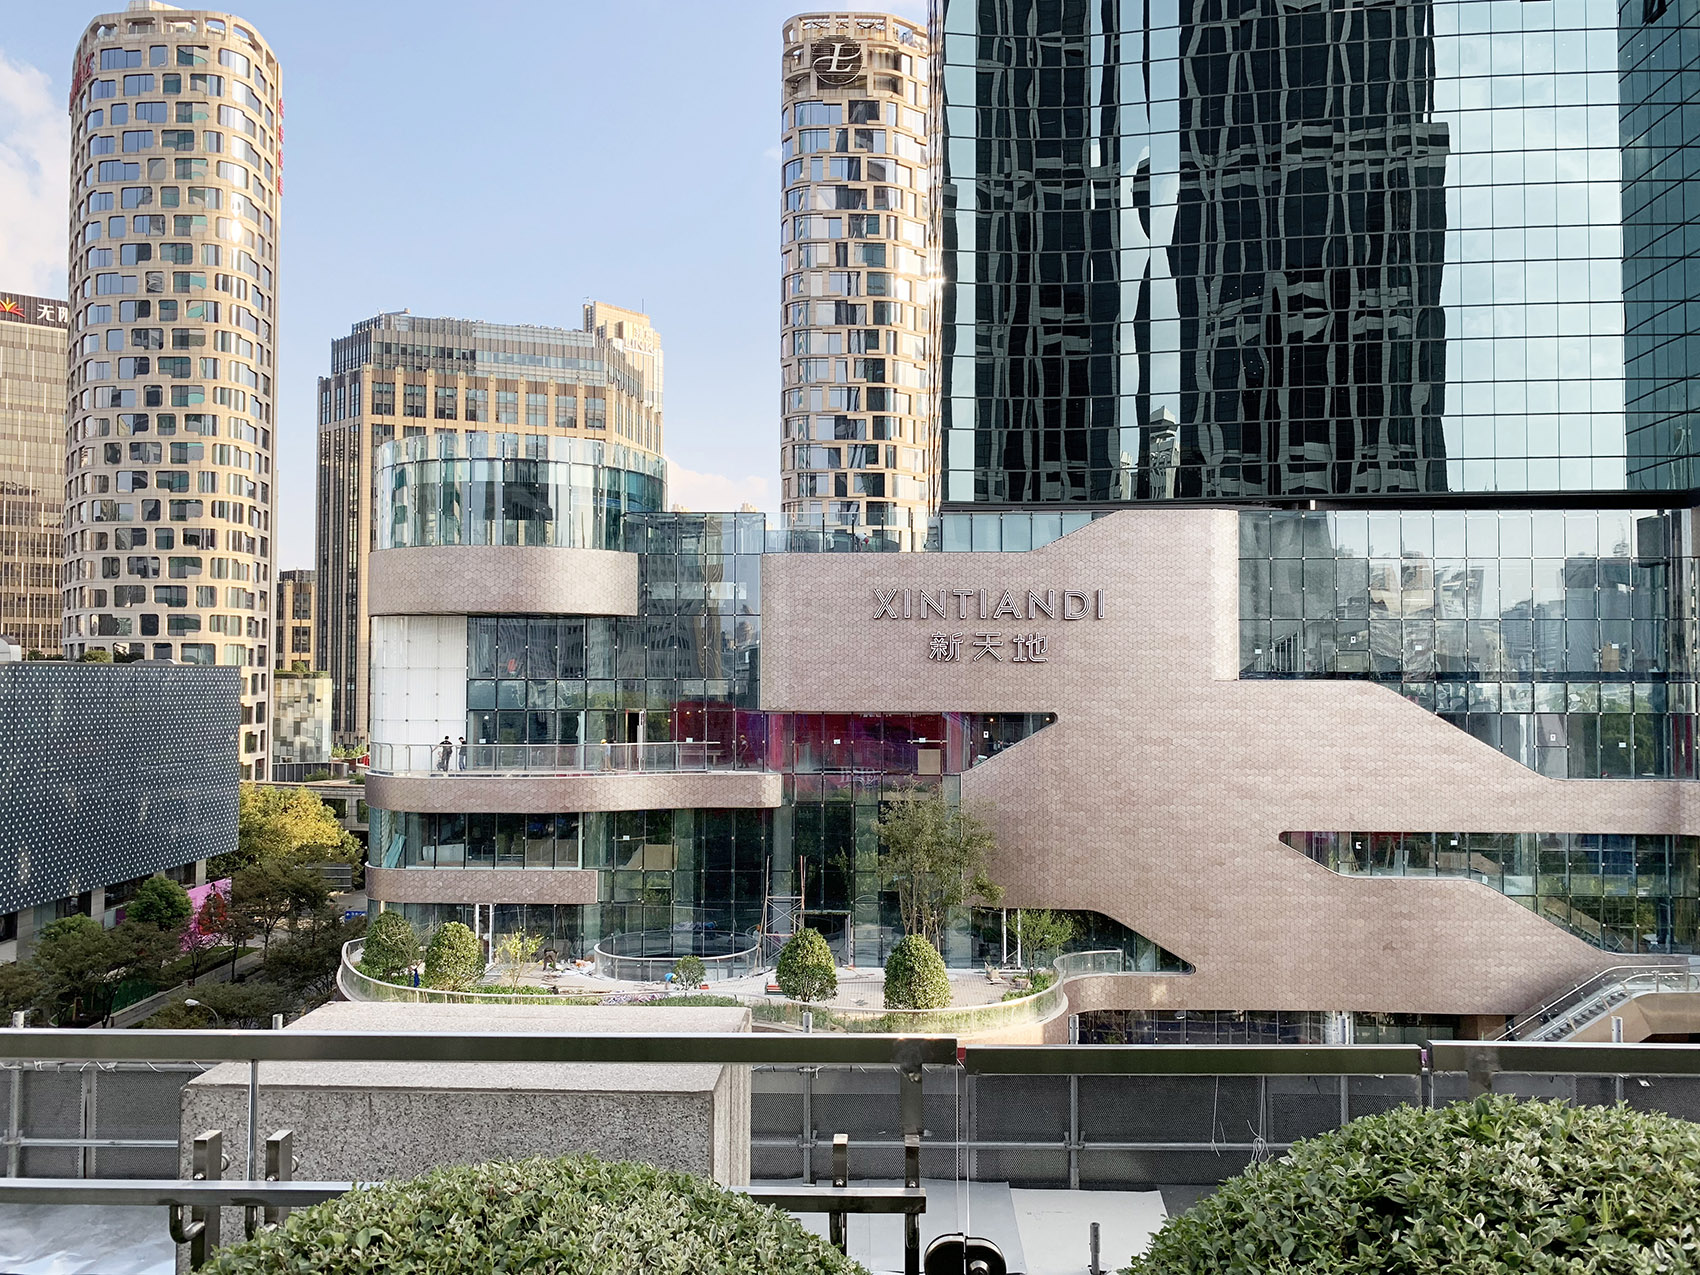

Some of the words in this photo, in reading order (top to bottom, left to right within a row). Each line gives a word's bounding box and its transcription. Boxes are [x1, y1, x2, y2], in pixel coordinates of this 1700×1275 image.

[873, 588, 1105, 620] XINTIANDI
[929, 631, 1049, 661] 新天地
